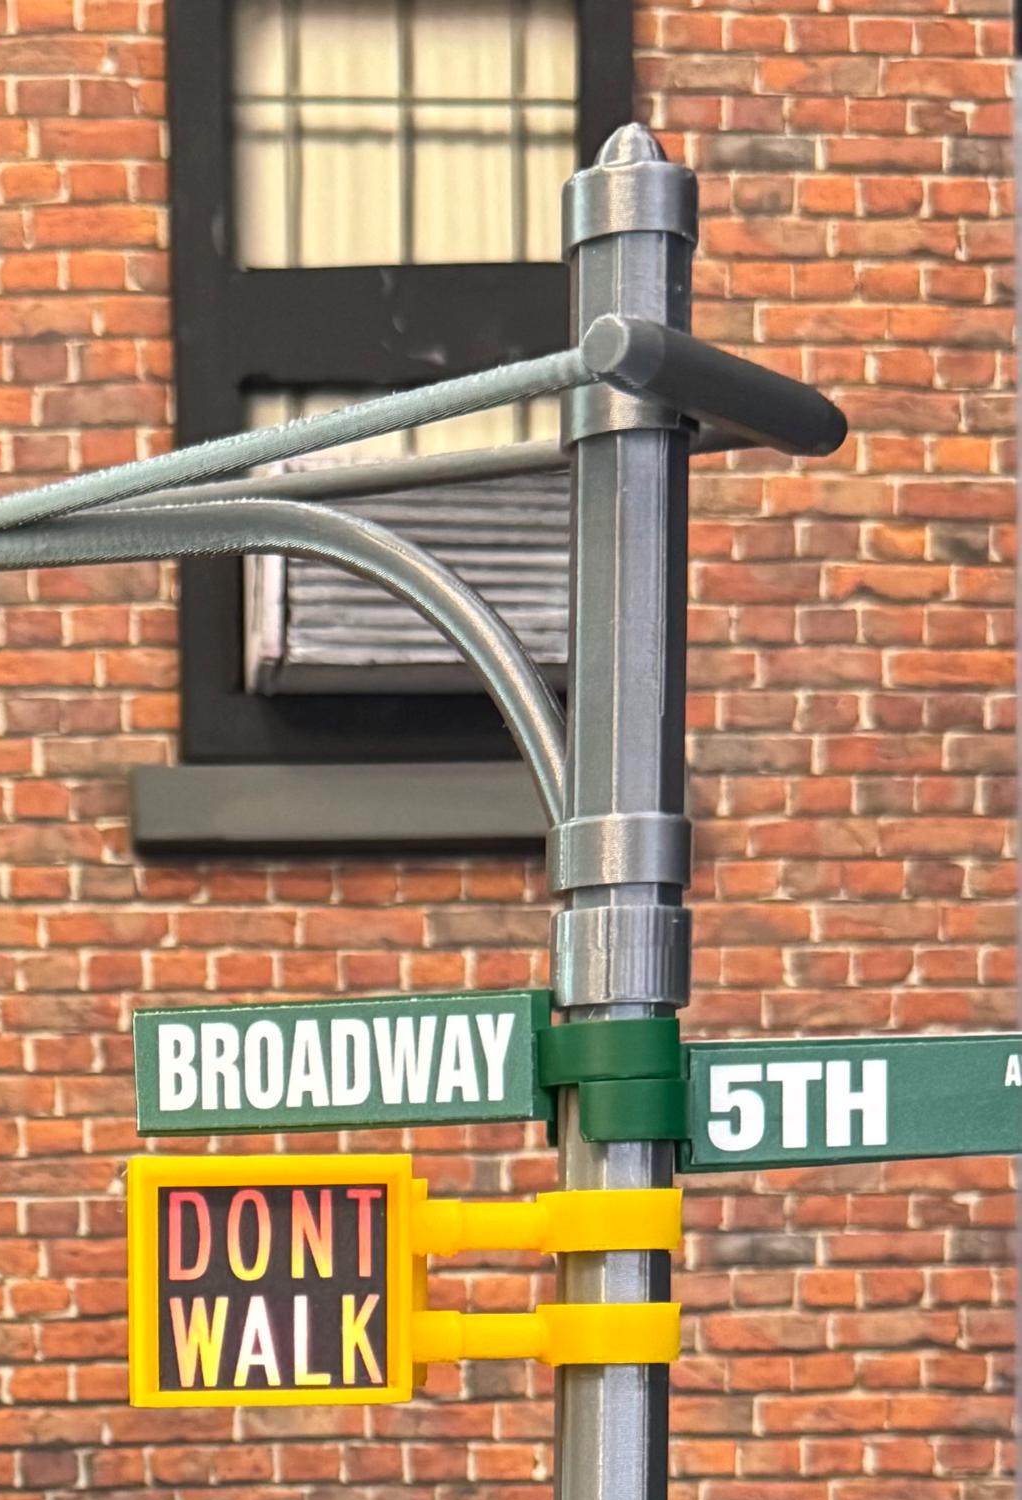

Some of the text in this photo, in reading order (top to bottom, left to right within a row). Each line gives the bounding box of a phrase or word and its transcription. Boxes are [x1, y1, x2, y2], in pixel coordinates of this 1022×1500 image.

[157, 1013, 515, 1112] BROADWAY
[707, 1058, 889, 1152] 5TH
[167, 1188, 383, 1282] DONT
[168, 1294, 384, 1388] WALK
